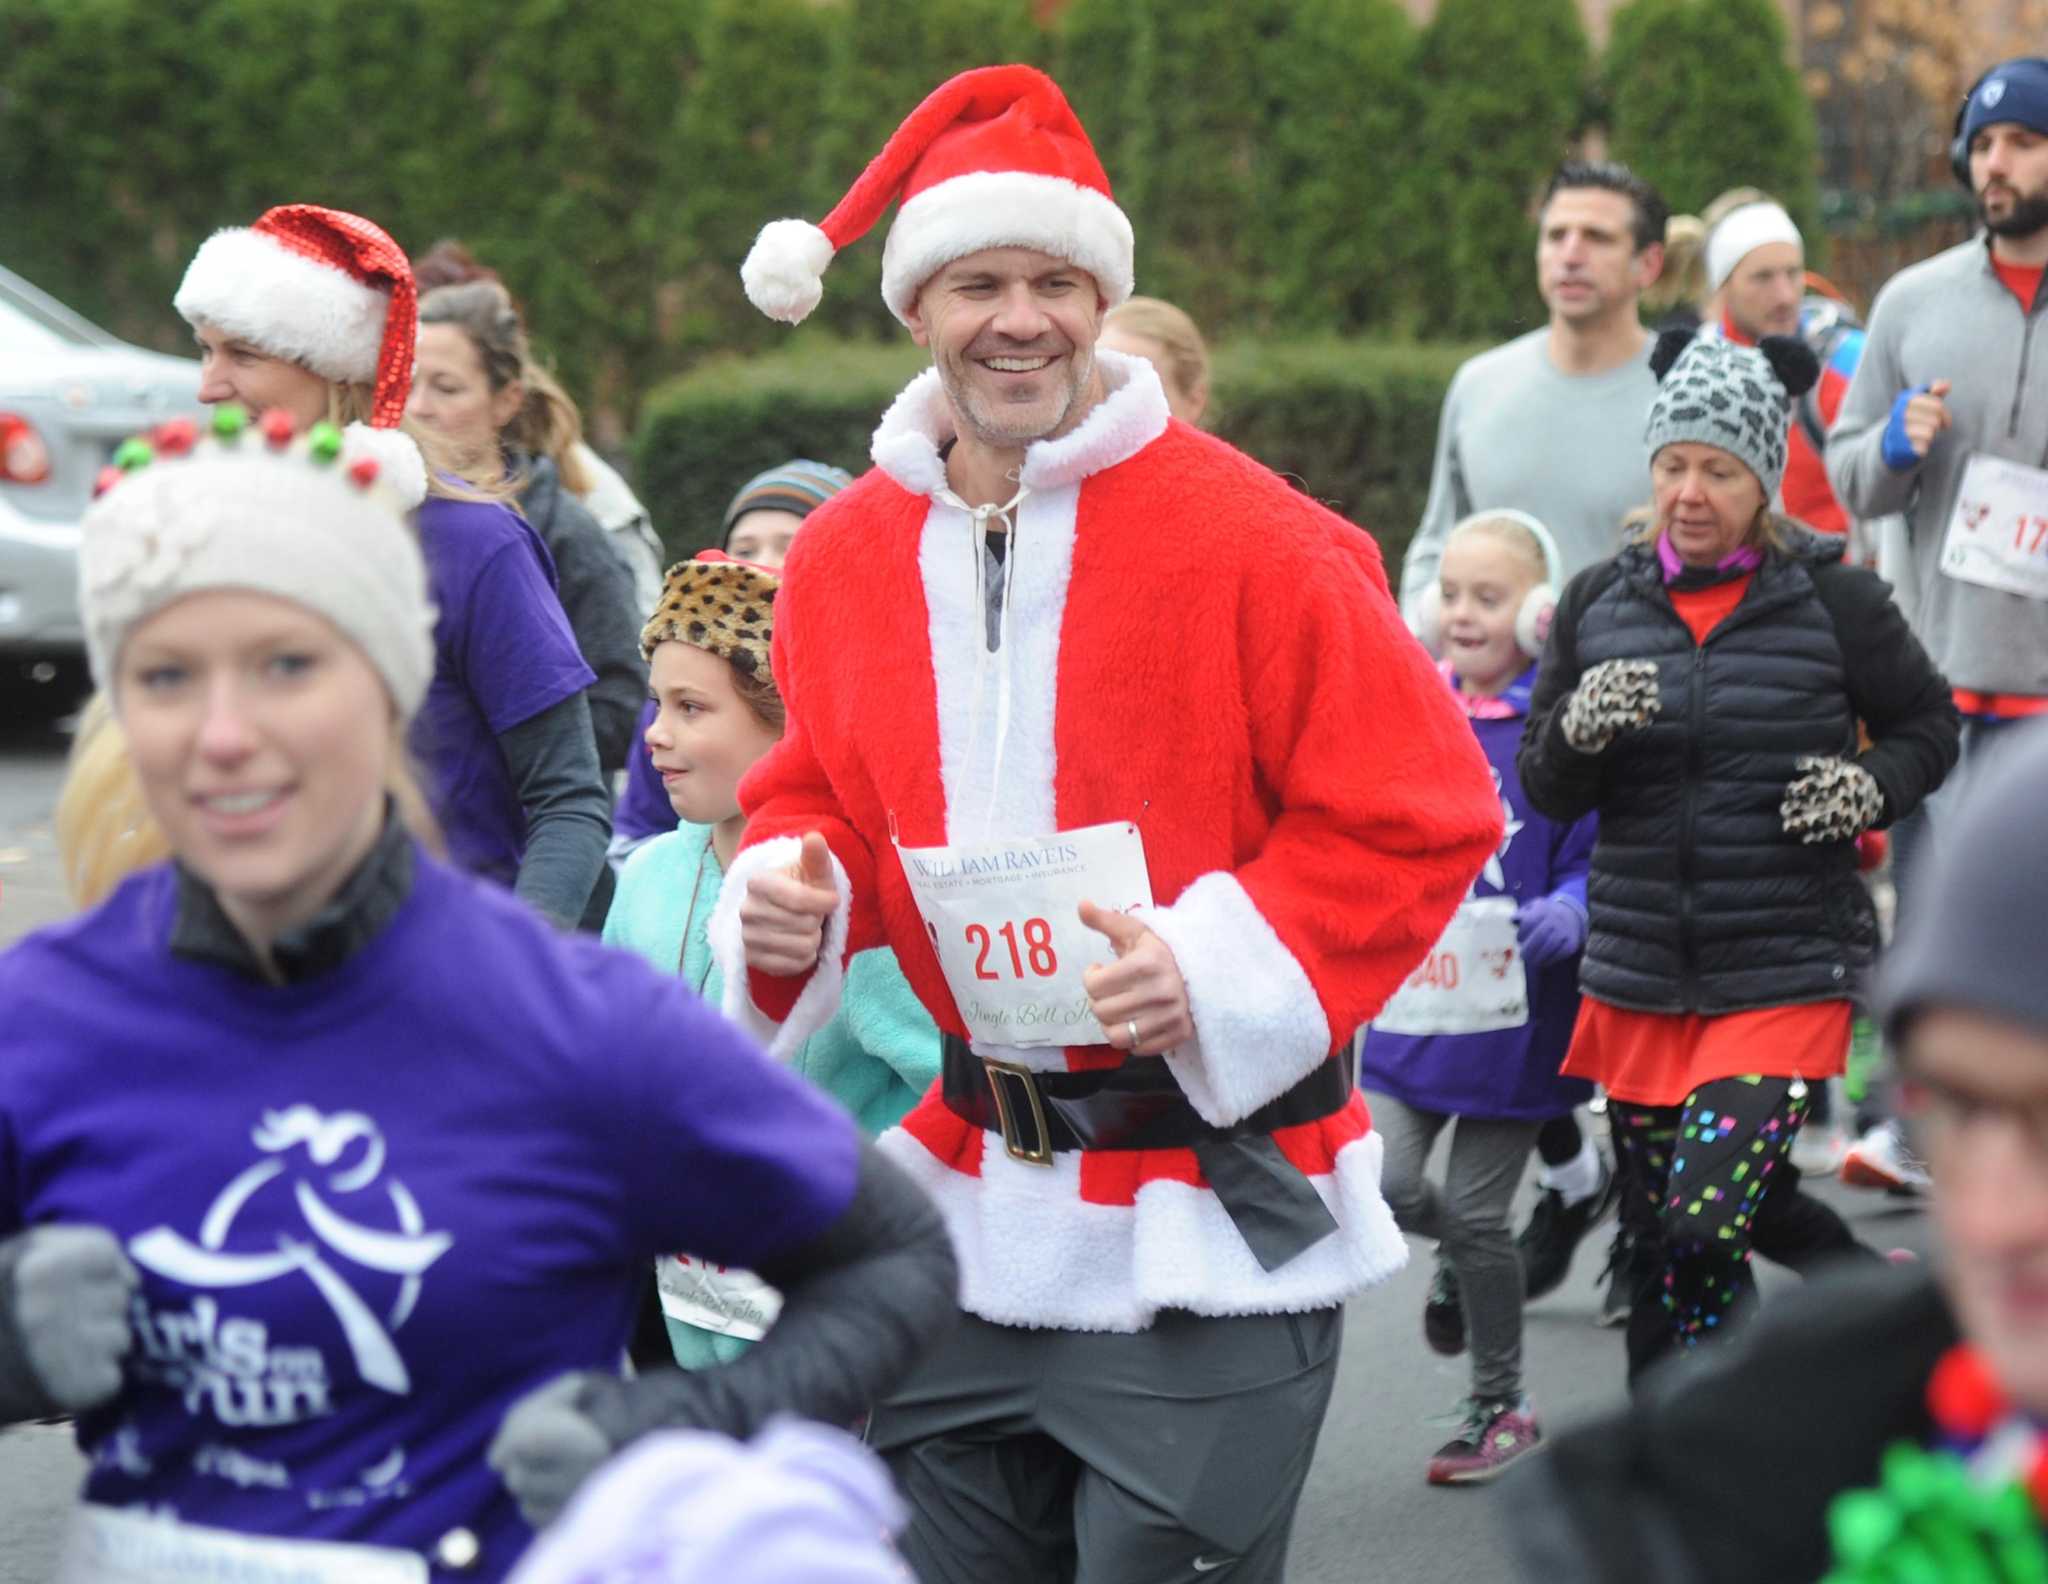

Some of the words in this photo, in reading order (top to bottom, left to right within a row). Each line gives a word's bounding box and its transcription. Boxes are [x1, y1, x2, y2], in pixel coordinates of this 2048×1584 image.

[912, 854, 1000, 878] WILLIAM
[1003, 844, 1078, 870] RAVEIS
[971, 873, 1022, 887] MORTGAGE
[964, 917, 1058, 981] 218
[964, 1000, 1010, 1029] Jingle
[1016, 1002, 1057, 1026] Bell
